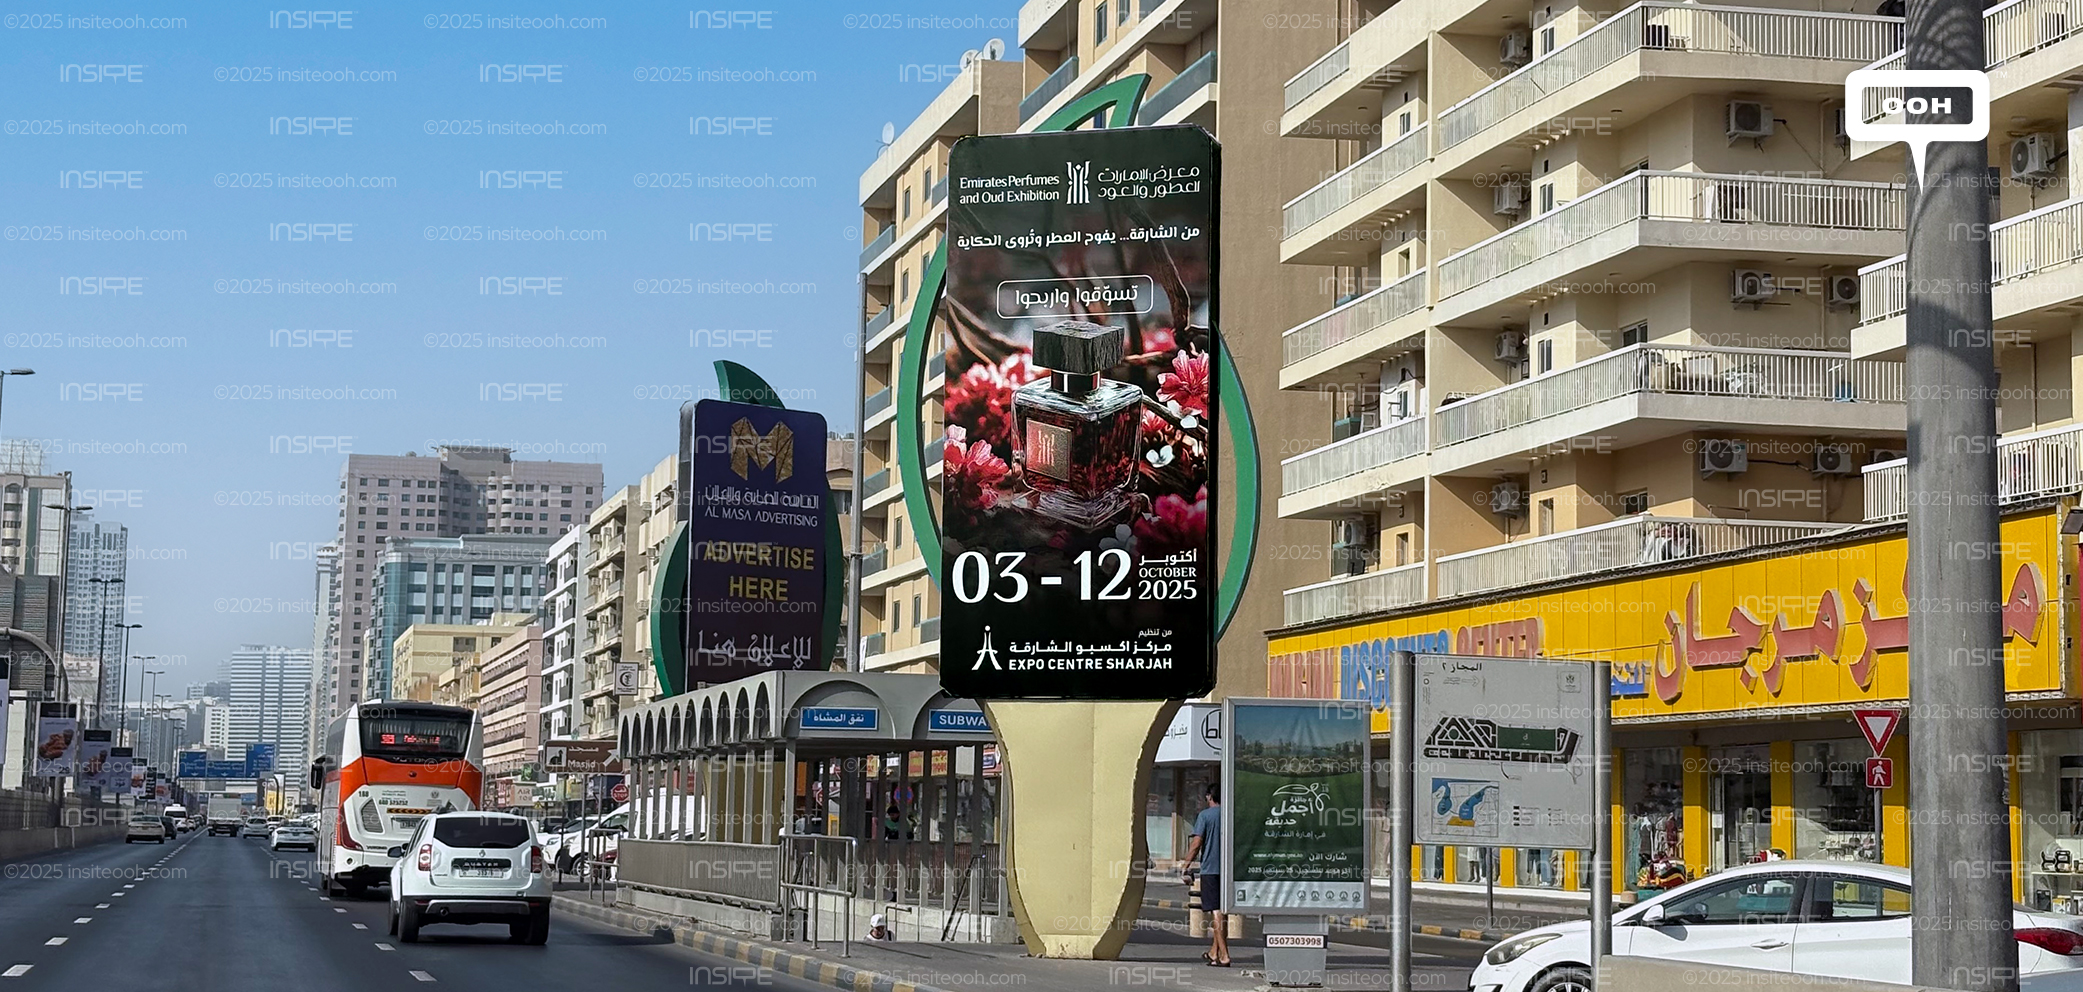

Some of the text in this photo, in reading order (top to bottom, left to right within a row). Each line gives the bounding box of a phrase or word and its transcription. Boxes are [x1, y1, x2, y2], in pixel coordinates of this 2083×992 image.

[960, 173, 1060, 189] Emirates Perfumes
[1149, 164, 1200, 182] معرض
[959, 190, 1060, 204] and Oud Exhibition
[1097, 184, 1148, 200] والعود
[1045, 230, 1081, 247] العطر
[1084, 230, 1116, 247] يفوح
[1180, 226, 1200, 241] من
[957, 234, 1002, 250] الحكاية
[1015, 288, 1070, 309] واربحوا
[704, 506, 819, 527] AL MASA ADVERTISING
[703, 540, 815, 571] ADVERTISE
[1138, 548, 1197, 567] أكتوبر
[952, 550, 1029, 604] 03
[1073, 548, 1132, 601] 12
[1138, 567, 1197, 579] OCTOBER
[729, 575, 789, 601] HERE
[1138, 580, 1198, 601] 2025
[1138, 627, 1173, 639] من تنظيم
[697, 629, 737, 658] هنا
[1008, 640, 1172, 656] مركز اكسبو الشارقة
[1654, 579, 1847, 705] مرجان
[1008, 657, 1173, 671] EXPO CENTRE SHARJAH
[1450, 661, 1482, 673] المجاز
[848, 713, 865, 725] نفق
[938, 714, 990, 726] SUBWA
[567, 759, 596, 769] Masjid
[1271, 797, 1314, 817] أجمل
[1264, 817, 1297, 828] حديقة
[1264, 830, 1294, 839] الشارقة
[1314, 831, 1326, 840] في
[1325, 852, 1347, 862] شارك
[1268, 937, 1322, 946] 0507303998
